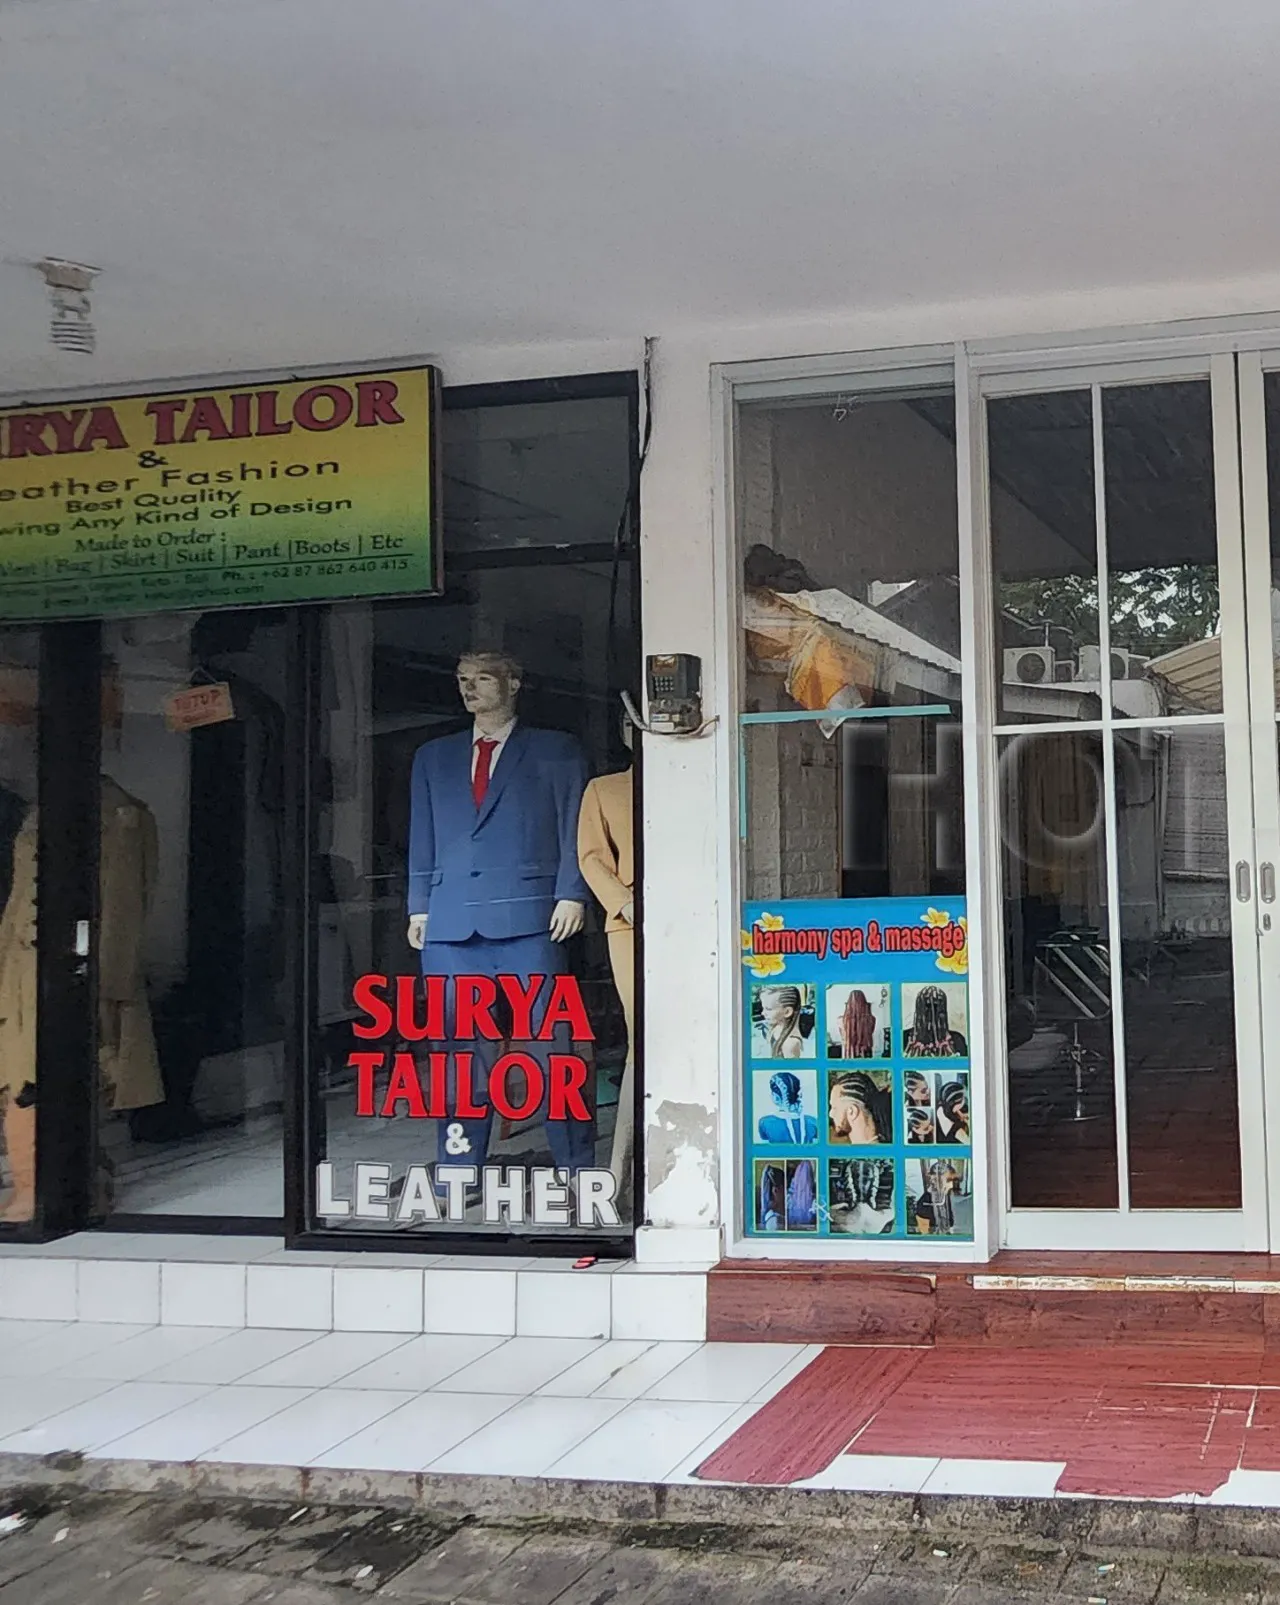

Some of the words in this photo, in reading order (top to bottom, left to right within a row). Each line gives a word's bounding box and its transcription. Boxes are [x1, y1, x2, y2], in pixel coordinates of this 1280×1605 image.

[0, 405, 129, 459] RYA
[145, 380, 405, 446] TAILOR
[138, 449, 168, 469] &
[161, 459, 340, 488] Fashion
[66, 497, 123, 514] Best
[134, 488, 242, 508] Quality
[70, 516, 125, 531] Any
[136, 507, 199, 525] Kind
[211, 503, 240, 519] of
[250, 496, 353, 516] Design
[74, 535, 129, 553] Made
[133, 534, 151, 548] to
[111, 554, 157, 569] Skirt
[177, 549, 216, 564] Suit
[234, 543, 281, 560] Pant
[295, 539, 350, 556] Boots
[370, 535, 404, 550] Etc
[752, 924, 828, 960] harmony
[831, 928, 863, 959] spa
[866, 921, 883, 952] &
[885, 922, 966, 957] massage
[352, 973, 596, 1042] SURYA
[347, 1051, 592, 1121] TAILOR
[445, 1122, 472, 1155] &
[315, 1160, 624, 1229] LEATHER
